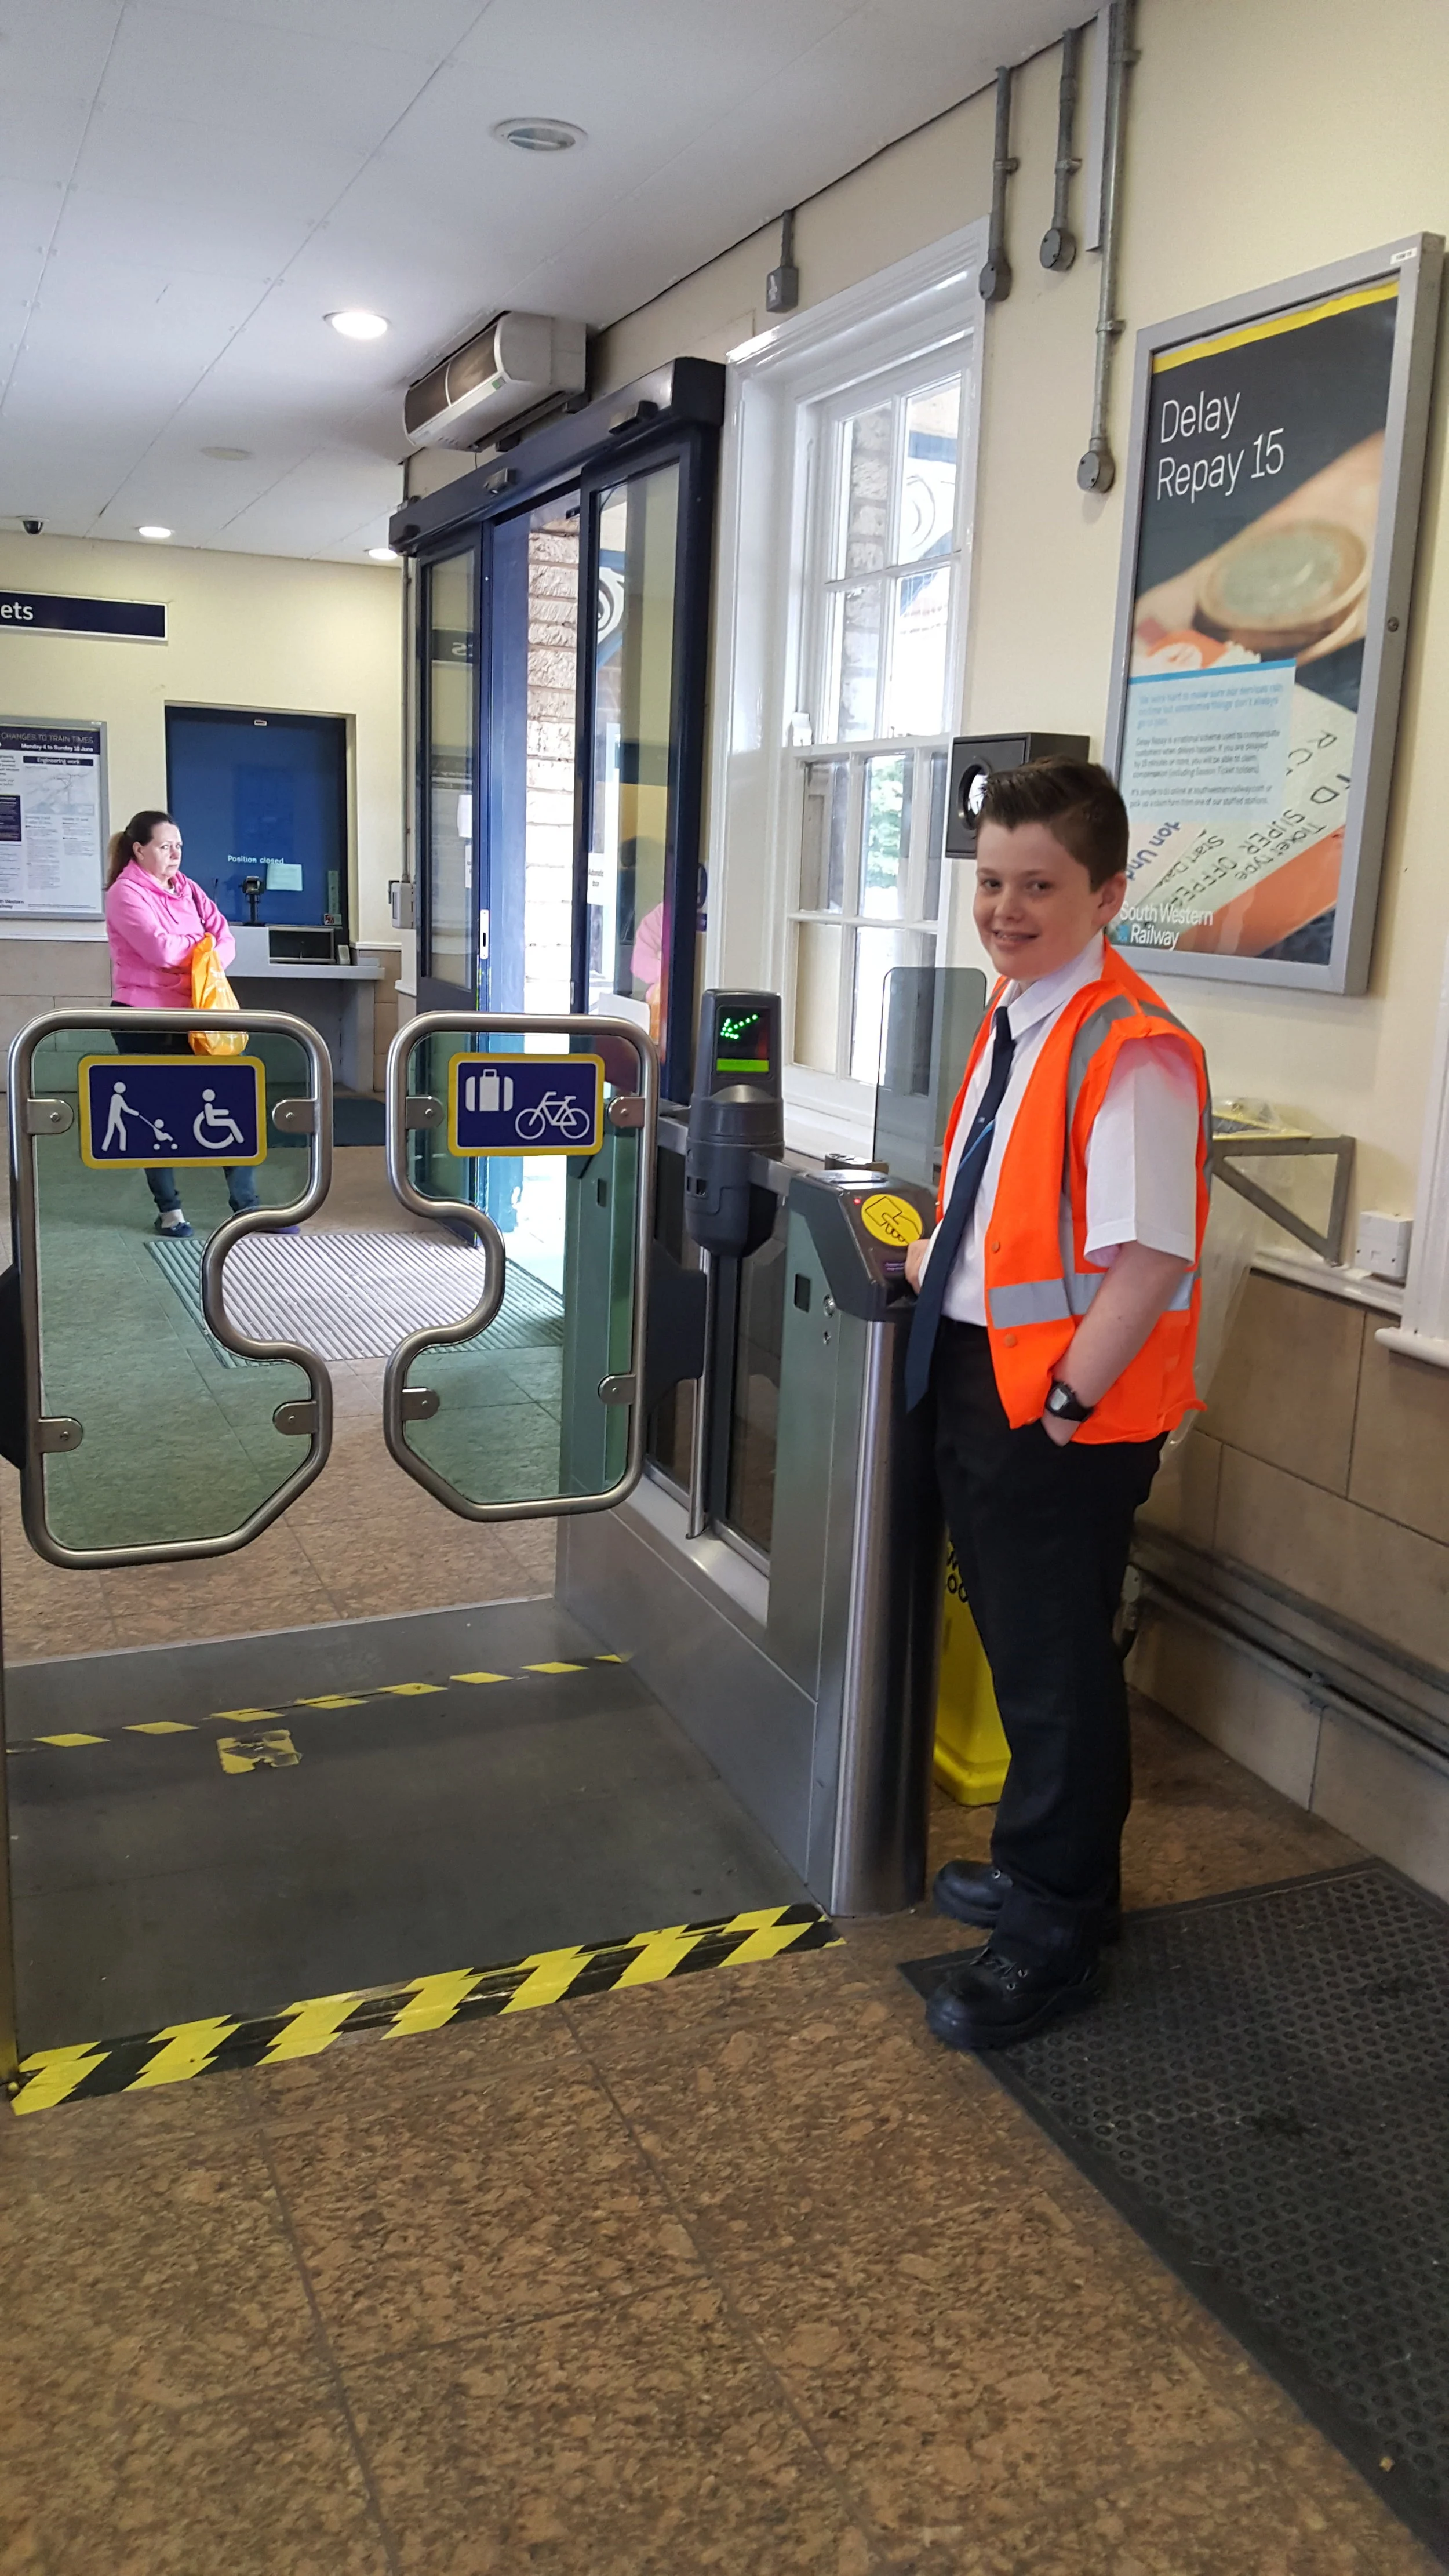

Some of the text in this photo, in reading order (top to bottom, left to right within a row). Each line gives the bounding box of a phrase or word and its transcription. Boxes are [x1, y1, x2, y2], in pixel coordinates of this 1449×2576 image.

[1161, 390, 1240, 443] Delay
[1157, 428, 1284, 504] Repay 15
[1, 602, 34, 620] ets
[1, 732, 36, 740] CHANGES
[228, 855, 257, 863] Position
[1119, 900, 1214, 926] South Western
[1130, 925, 1181, 951] Railway
